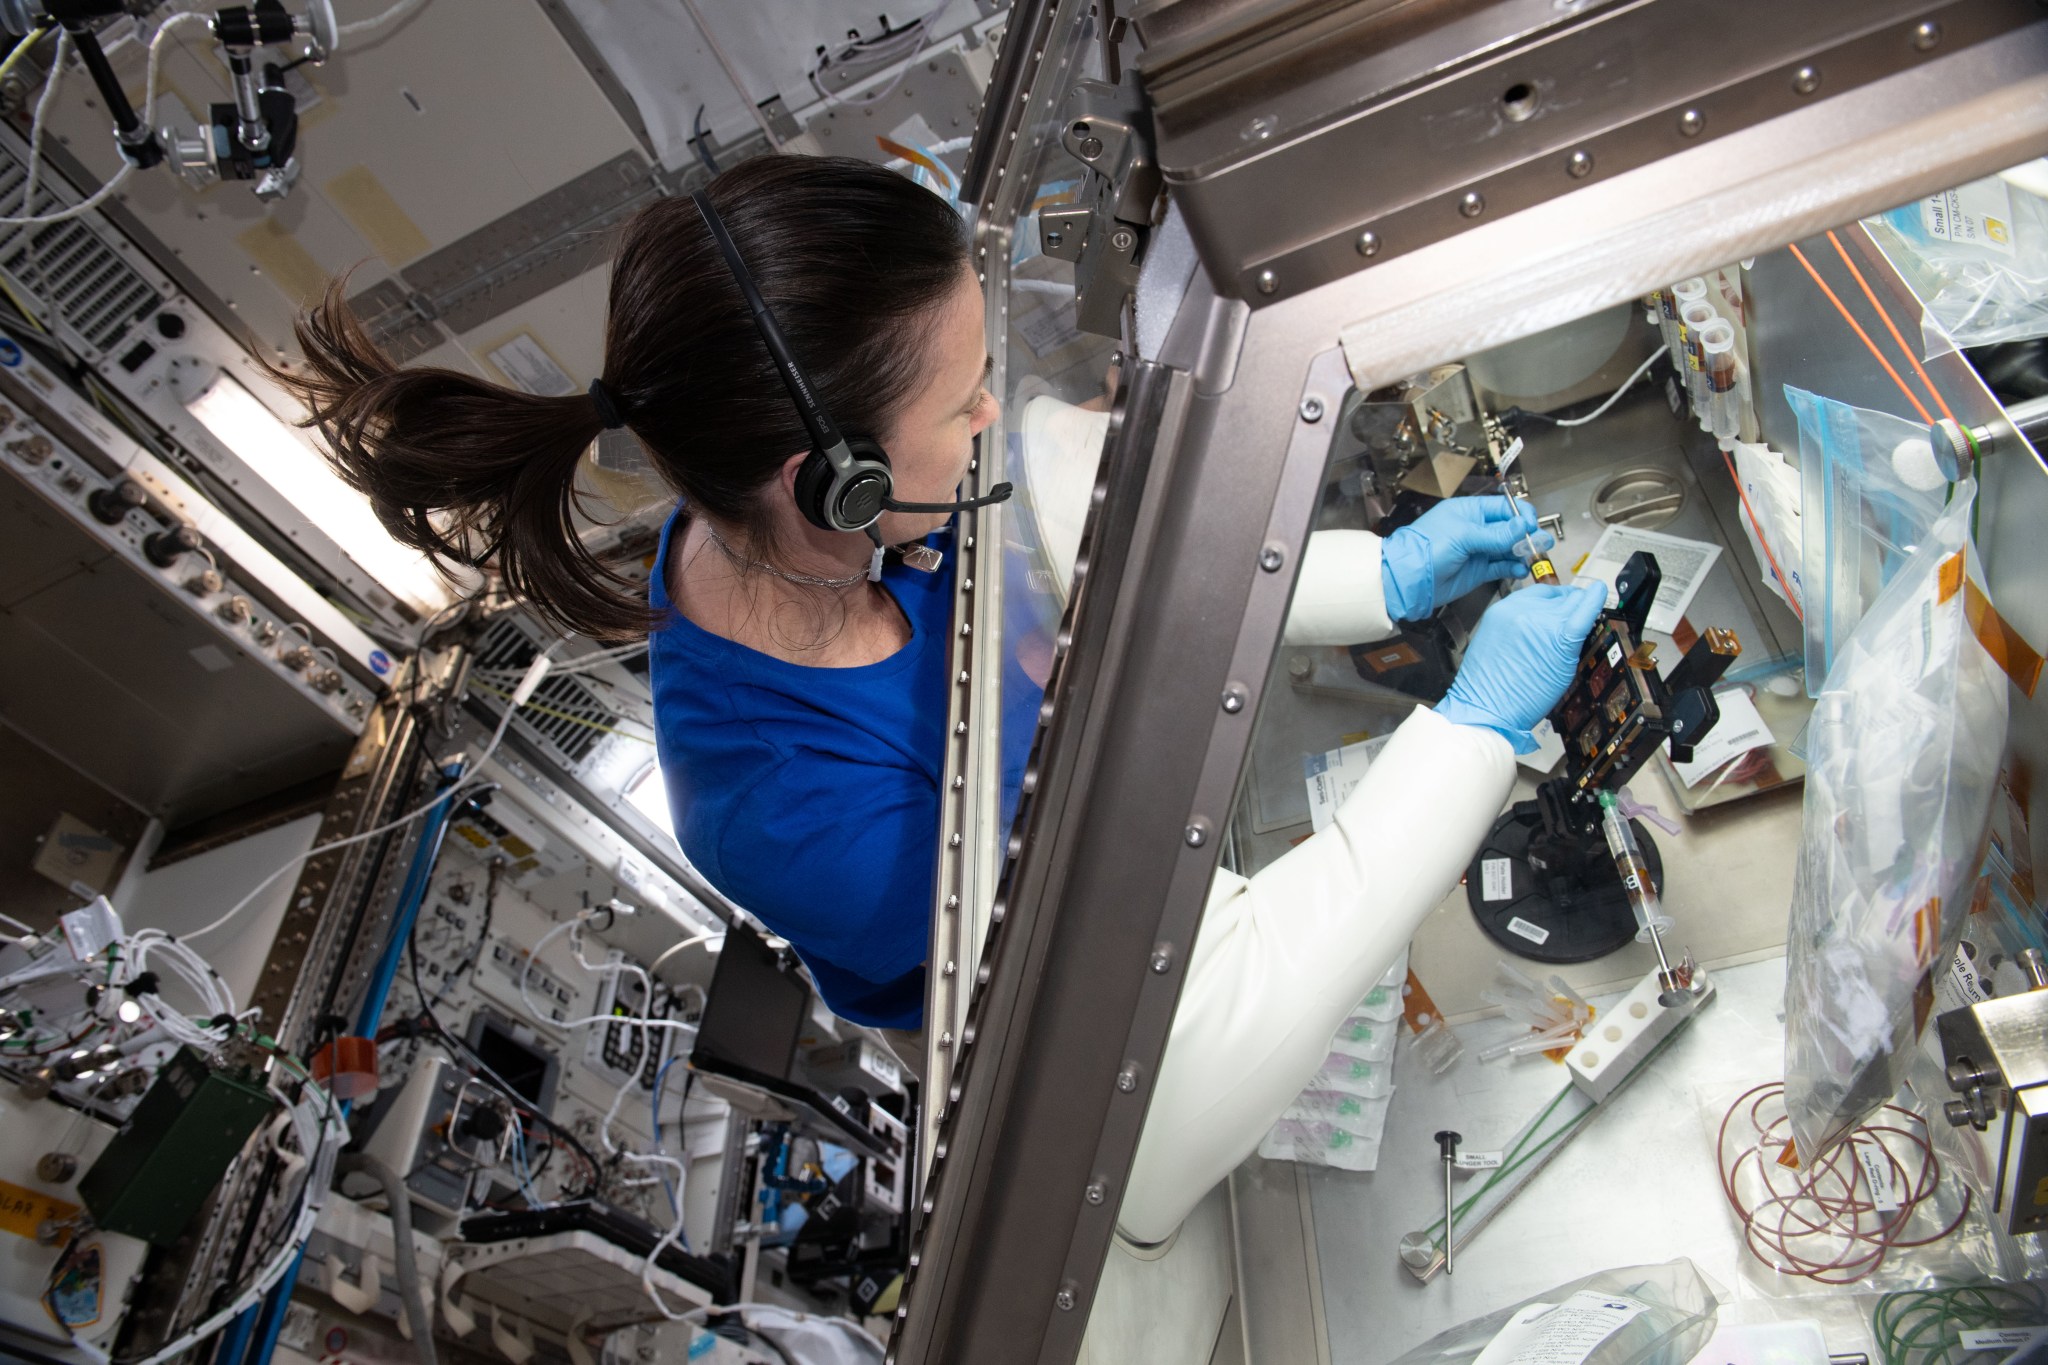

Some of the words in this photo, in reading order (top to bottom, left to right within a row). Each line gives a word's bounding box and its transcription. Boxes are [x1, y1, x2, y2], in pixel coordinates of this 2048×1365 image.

[1932, 206, 1944, 235] Small
[787, 361, 815, 408] SENNHEISER
[816, 415, 830, 434] EPOS
